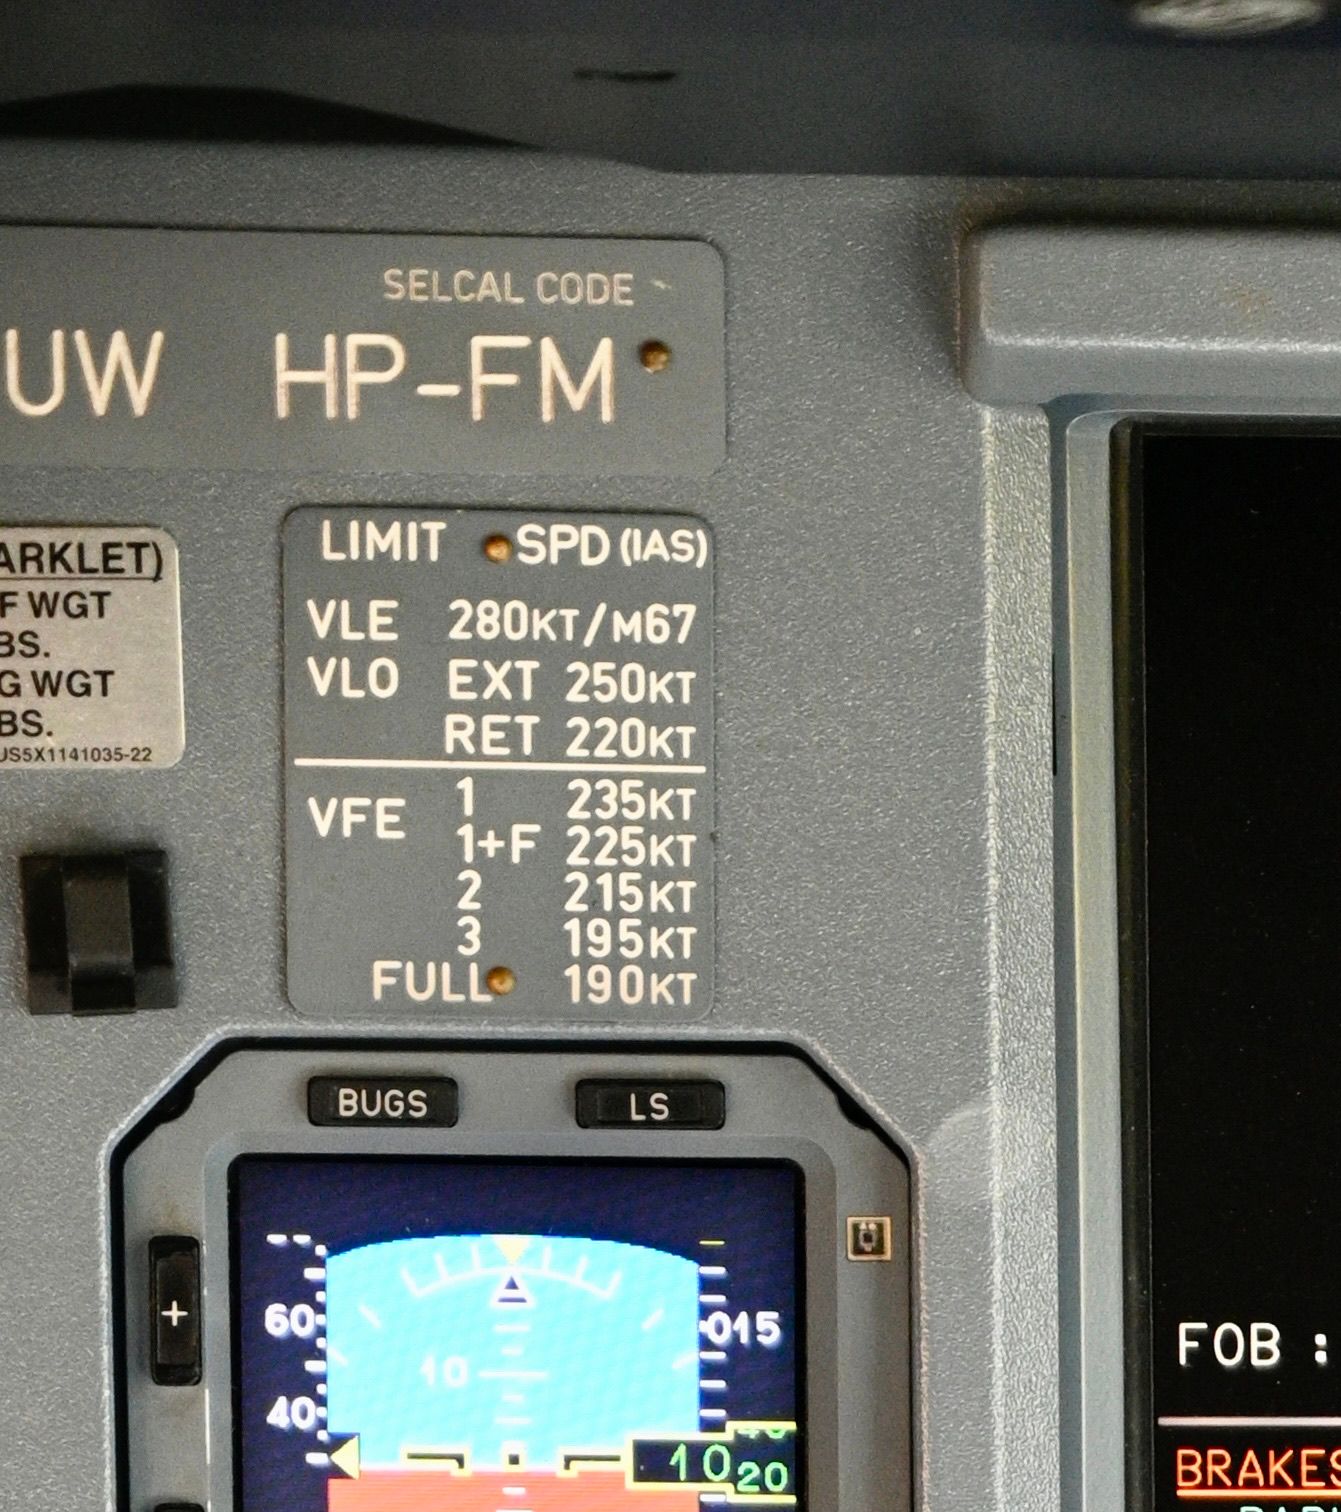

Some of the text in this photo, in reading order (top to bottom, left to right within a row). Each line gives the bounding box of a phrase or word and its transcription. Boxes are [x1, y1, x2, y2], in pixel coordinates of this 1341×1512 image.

[383, 268, 635, 307] SELCAL CODE
[275, 332, 615, 425] HP-FM
[321, 519, 708, 569] LIMIT SPD (IAS)
[306, 598, 697, 648] VLE 280KT/M67
[306, 656, 697, 705] VLO EXT 250KT
[444, 713, 697, 759] RET 220KT
[566, 778, 697, 821] 235KT
[307, 796, 697, 868] VFE 225KT
[564, 870, 697, 913] 215KT
[563, 917, 698, 960] 195KT
[372, 960, 698, 1006] FULL 190KT
[338, 1087, 428, 1118] BUGS
[630, 1092, 670, 1121] LS
[1178, 1322, 1281, 1368] FOB
